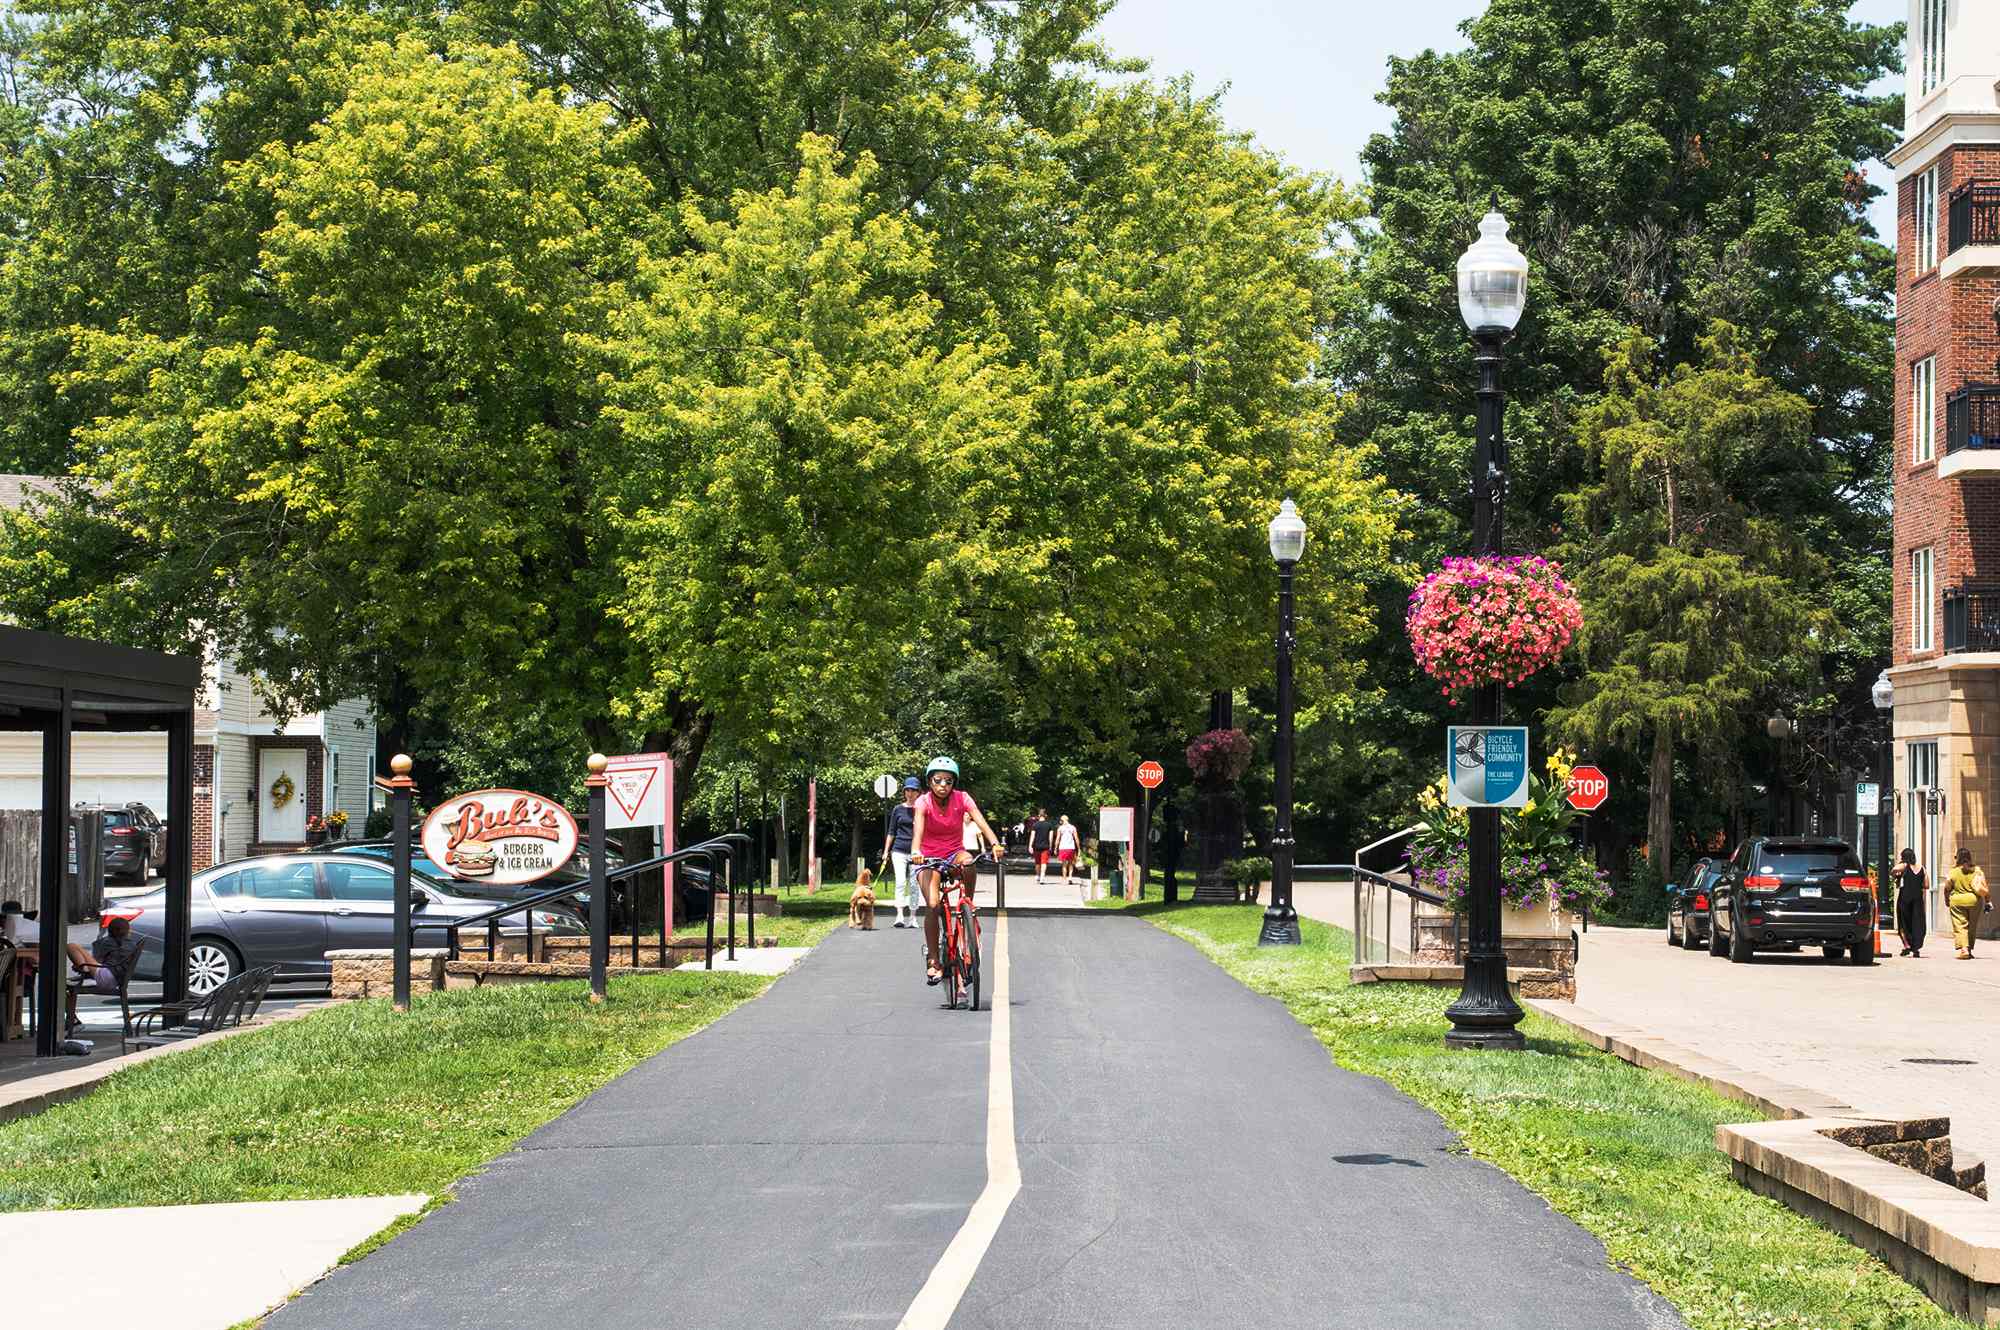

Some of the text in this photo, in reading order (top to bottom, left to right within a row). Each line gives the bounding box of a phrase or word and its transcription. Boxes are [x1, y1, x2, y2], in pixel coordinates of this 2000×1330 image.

[1488, 735, 1513, 744] BICYCLE
[1488, 744, 1518, 753] FRIENDLY
[1488, 753, 1523, 762] COMMUNITY
[1139, 768, 1162, 780] STOP
[1567, 779, 1605, 796] STOP
[447, 797, 560, 850] Bub's
[503, 843, 544, 856] BURGERS
[498, 857, 553, 869] & ICE CREAM
